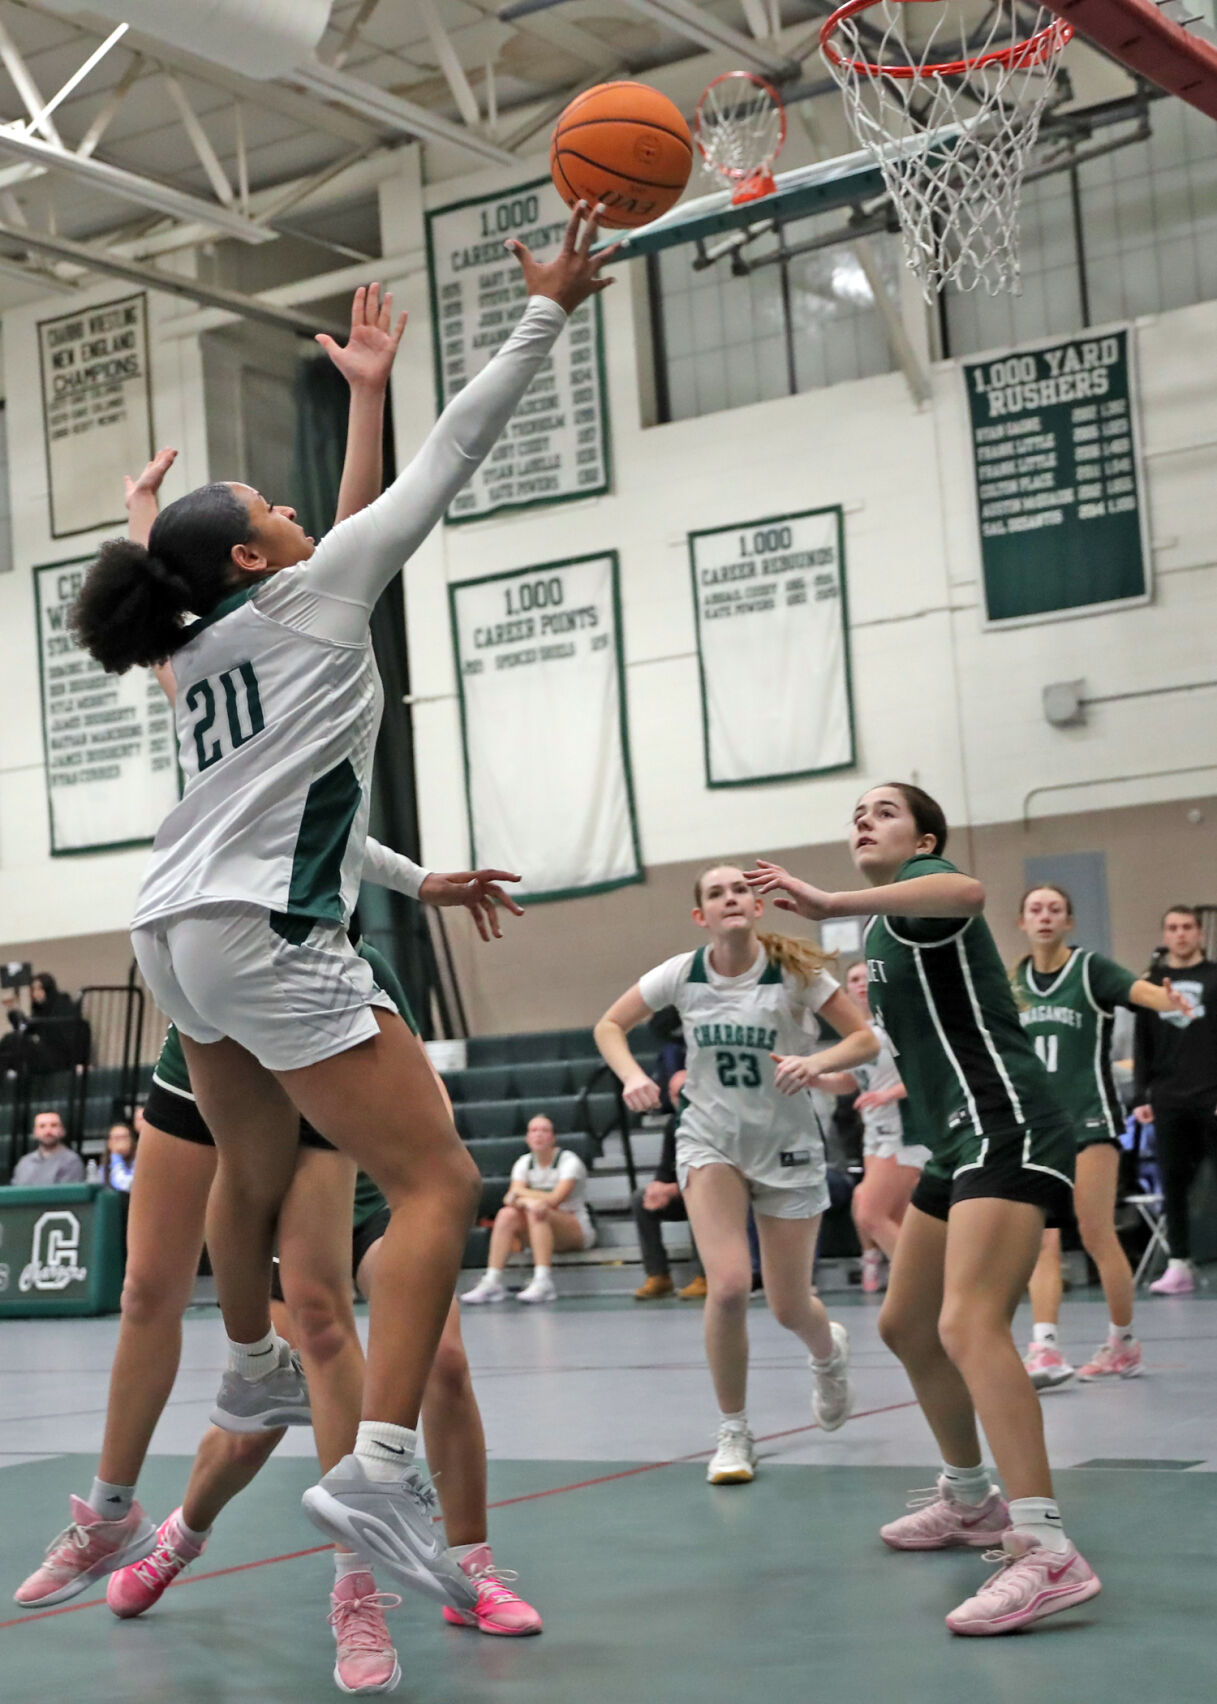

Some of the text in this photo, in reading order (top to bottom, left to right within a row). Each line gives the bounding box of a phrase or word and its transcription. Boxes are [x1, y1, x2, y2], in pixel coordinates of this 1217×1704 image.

[53, 353, 139, 394] CHAMPIONS
[1043, 337, 1119, 377] YARD
[987, 368, 1110, 418] RUSHERS
[701, 546, 834, 587] CAREER REBOUNDS
[474, 605, 599, 649] CAREER POINTS
[185, 660, 265, 772] 20
[693, 1023, 779, 1051] CHARGERS
[1034, 1035, 1058, 1072] 11
[716, 1051, 763, 1088] 23
[32, 1211, 80, 1289] C
